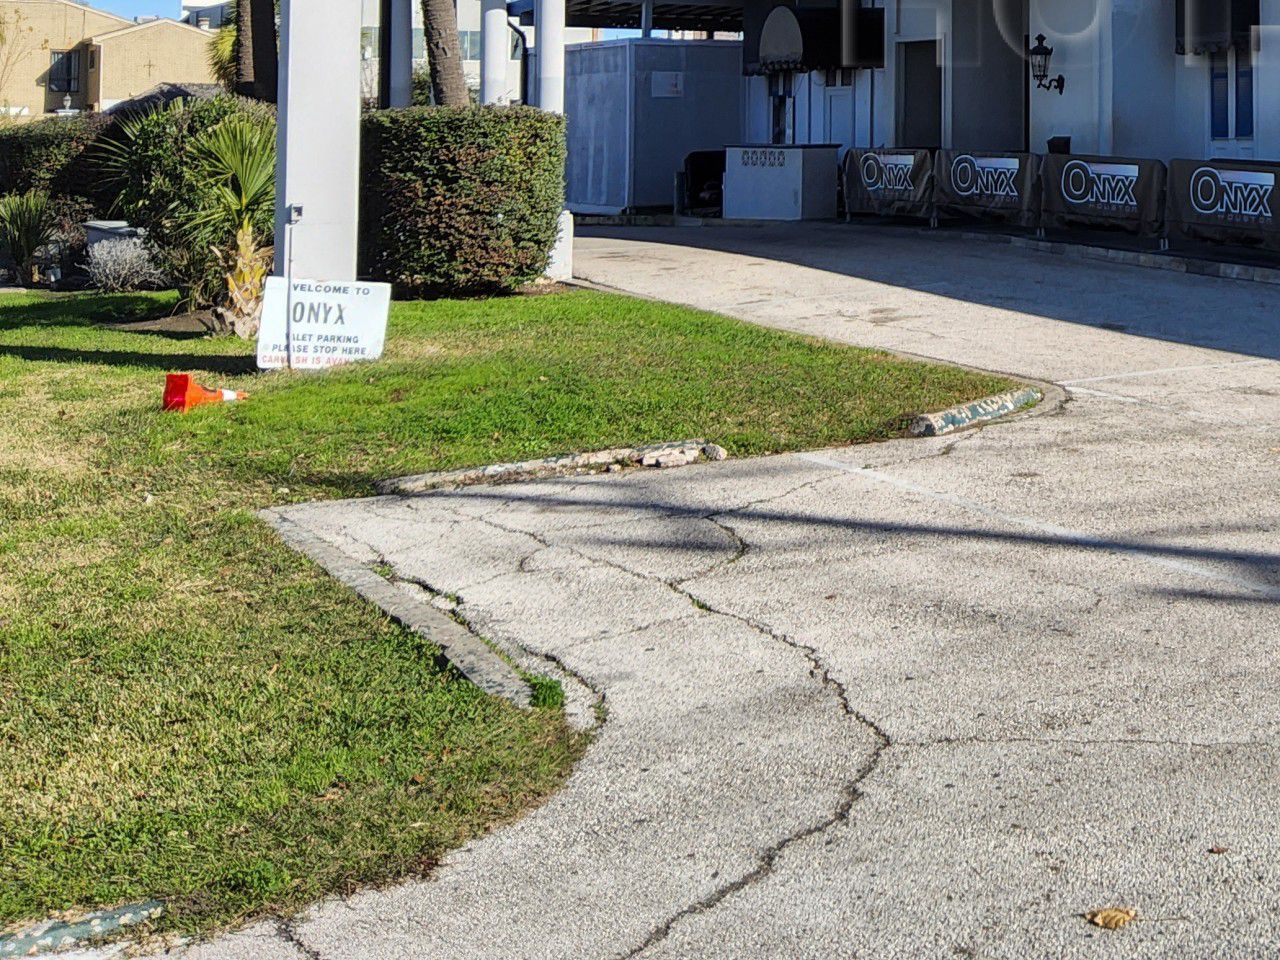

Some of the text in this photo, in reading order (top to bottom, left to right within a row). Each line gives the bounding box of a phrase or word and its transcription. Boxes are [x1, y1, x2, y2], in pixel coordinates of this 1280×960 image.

[860, 153, 914, 190] ONYX
[951, 155, 1018, 195] ONYX
[1061, 160, 1137, 205] ONYX
[1190, 167, 1273, 217] ONYX
[355, 287, 370, 296] TO
[292, 301, 345, 325] ONYX
[313, 345, 338, 354] STOP
[342, 347, 367, 356] HERE
[316, 334, 359, 344] PARKING
